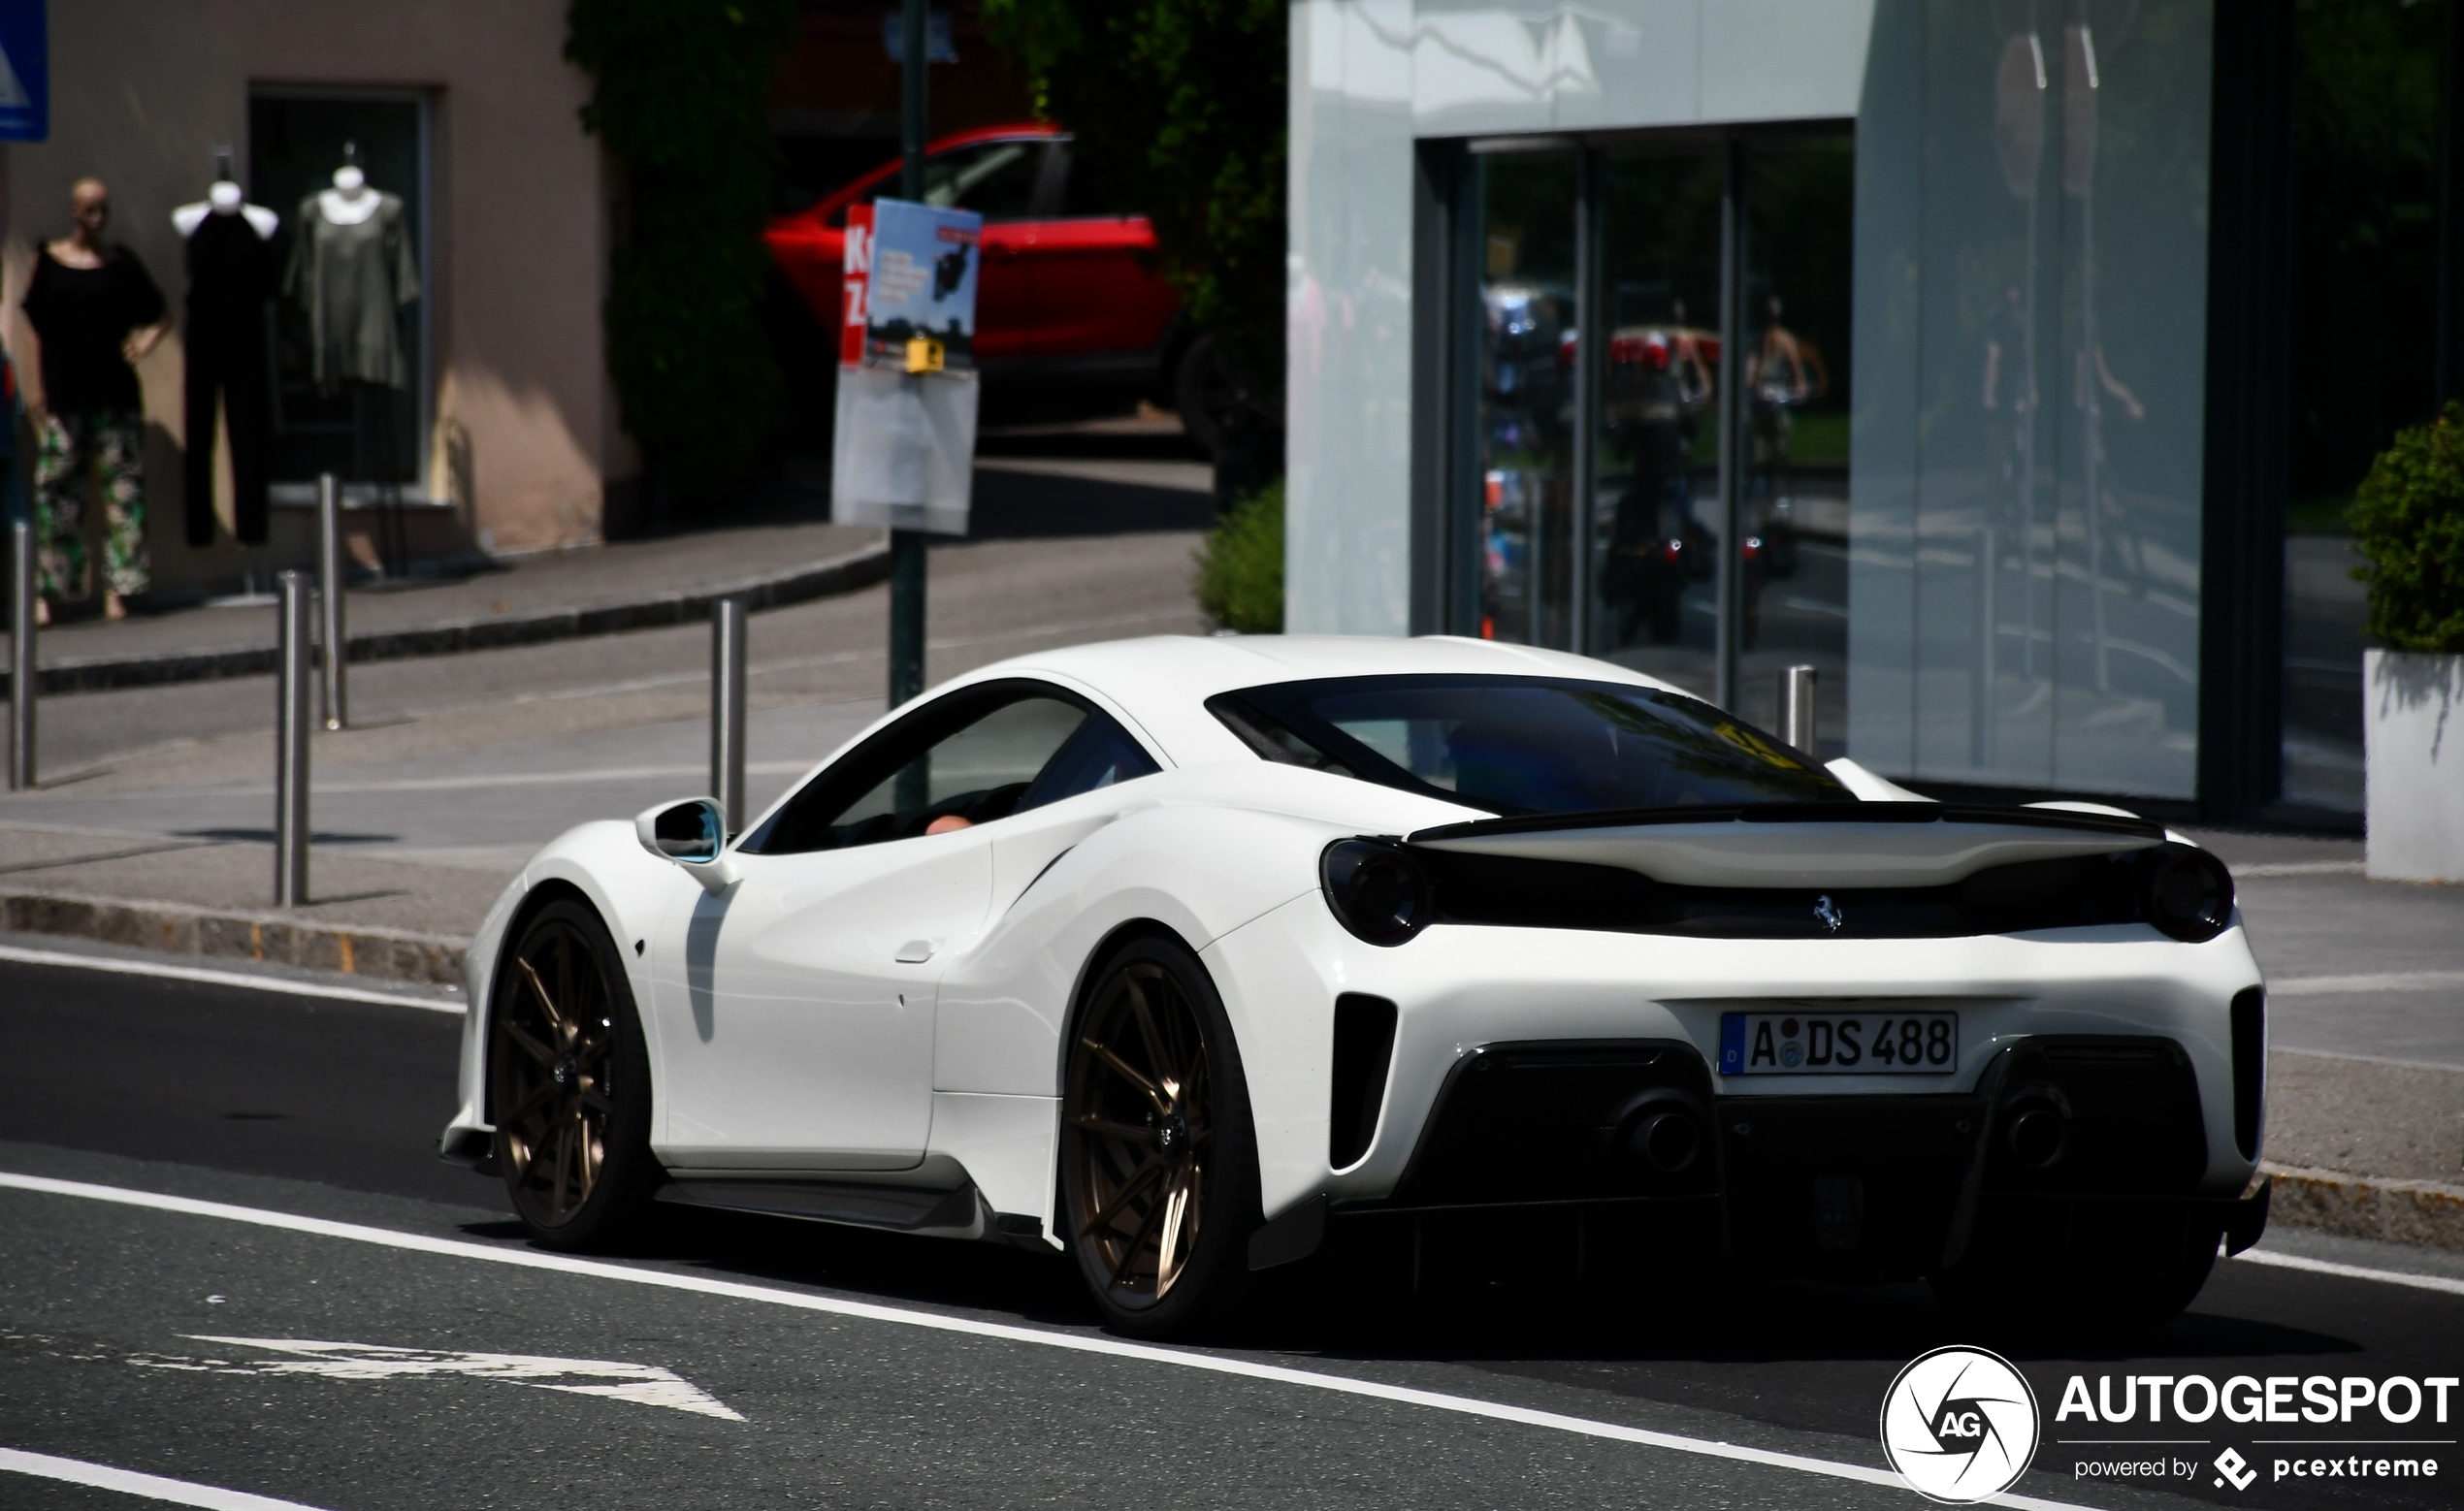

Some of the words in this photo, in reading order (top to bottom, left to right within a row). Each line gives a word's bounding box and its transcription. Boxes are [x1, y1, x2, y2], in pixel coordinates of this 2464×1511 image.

[1727, 1049, 1737, 1063] D
[1750, 1021, 1776, 1067] A
[1806, 1020, 1862, 1066] DS
[1871, 1019, 1951, 1066] 488
